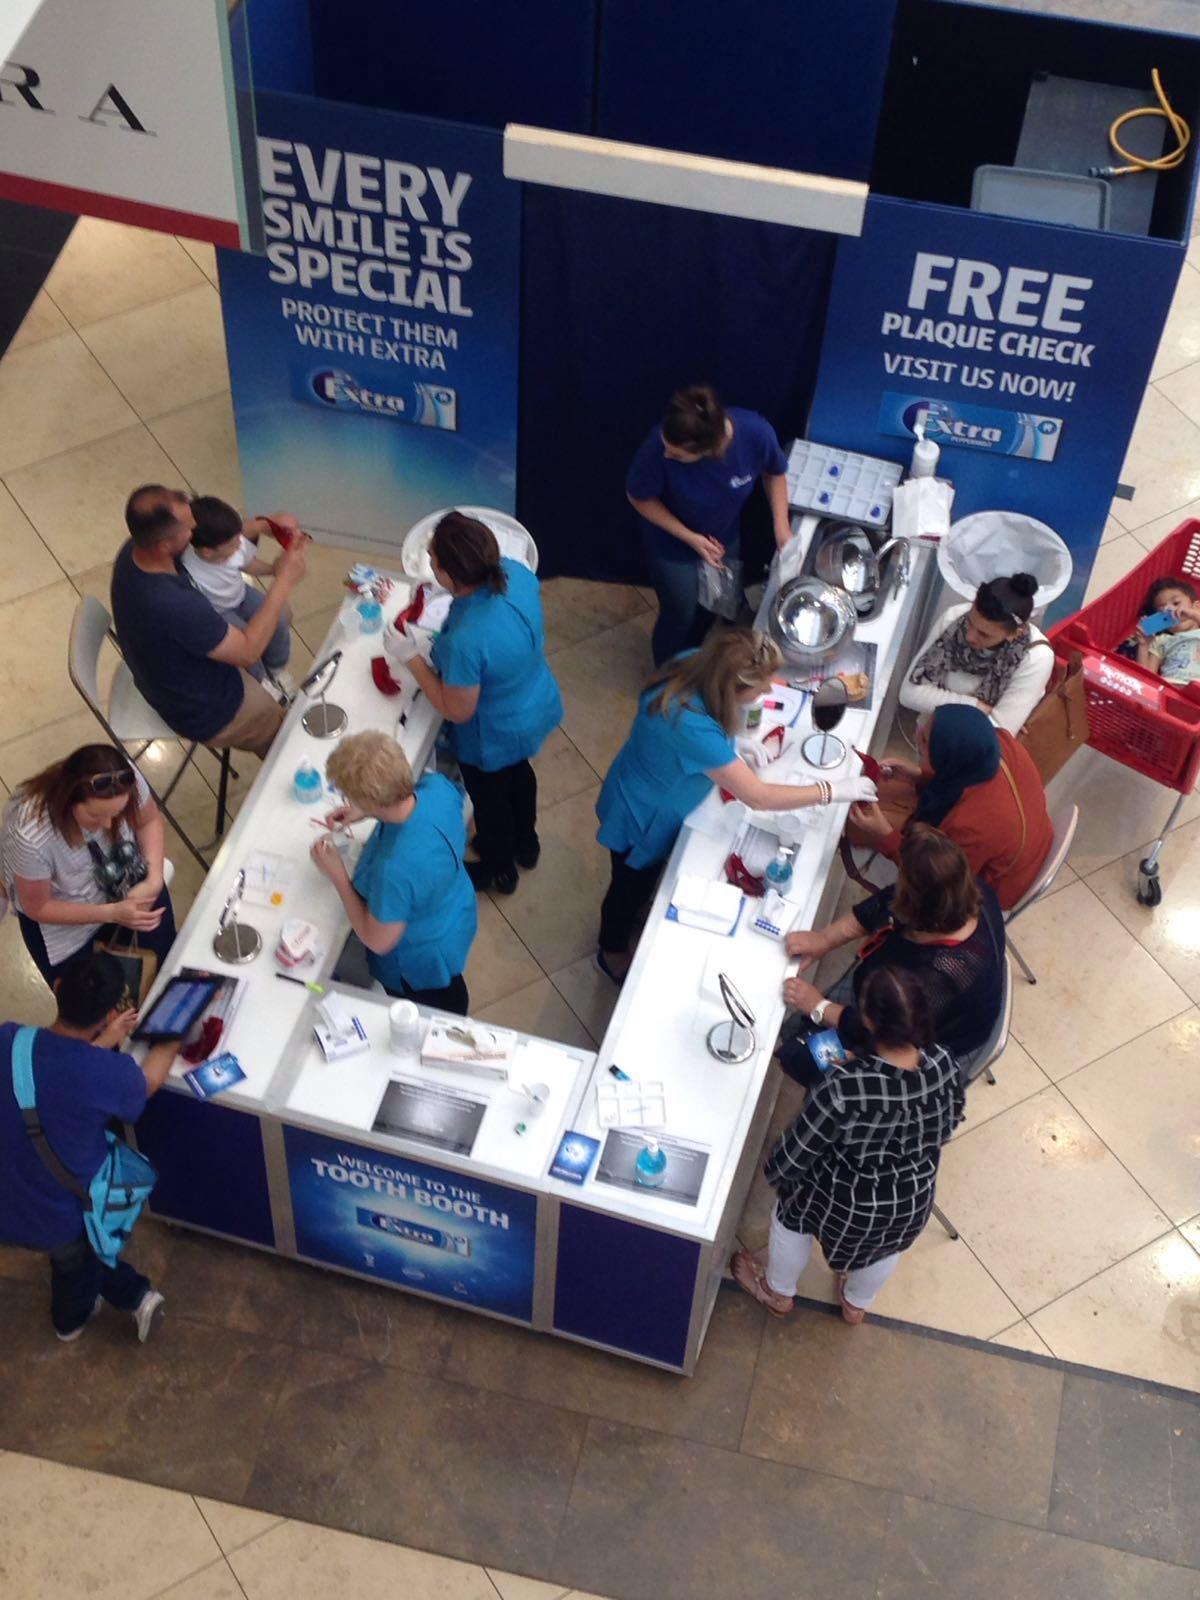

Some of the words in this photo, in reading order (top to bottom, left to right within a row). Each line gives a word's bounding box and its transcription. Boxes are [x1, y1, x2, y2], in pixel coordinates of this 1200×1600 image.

[257, 136, 473, 227] EVERY
[262, 198, 411, 261] SMILE
[419, 225, 473, 272] IS
[266, 242, 473, 317] SPECIAL
[907, 252, 1093, 334] FREE
[281, 298, 385, 336] PROTECT
[390, 316, 458, 350] THEM
[295, 324, 364, 356] WITH
[371, 337, 446, 371] EXTRA
[881, 312, 995, 351] PLAQUE
[999, 331, 1095, 367] CHECK
[884, 352, 957, 383] VISIT
[960, 365, 994, 390] US
[999, 371, 1076, 403] NOW!
[311, 1158, 407, 1199] TOOTH
[414, 1189, 510, 1230] BOOTH
[336, 1153, 421, 1188] WELCOME
[425, 1179, 447, 1194] TO
[450, 1187, 482, 1204] THE
